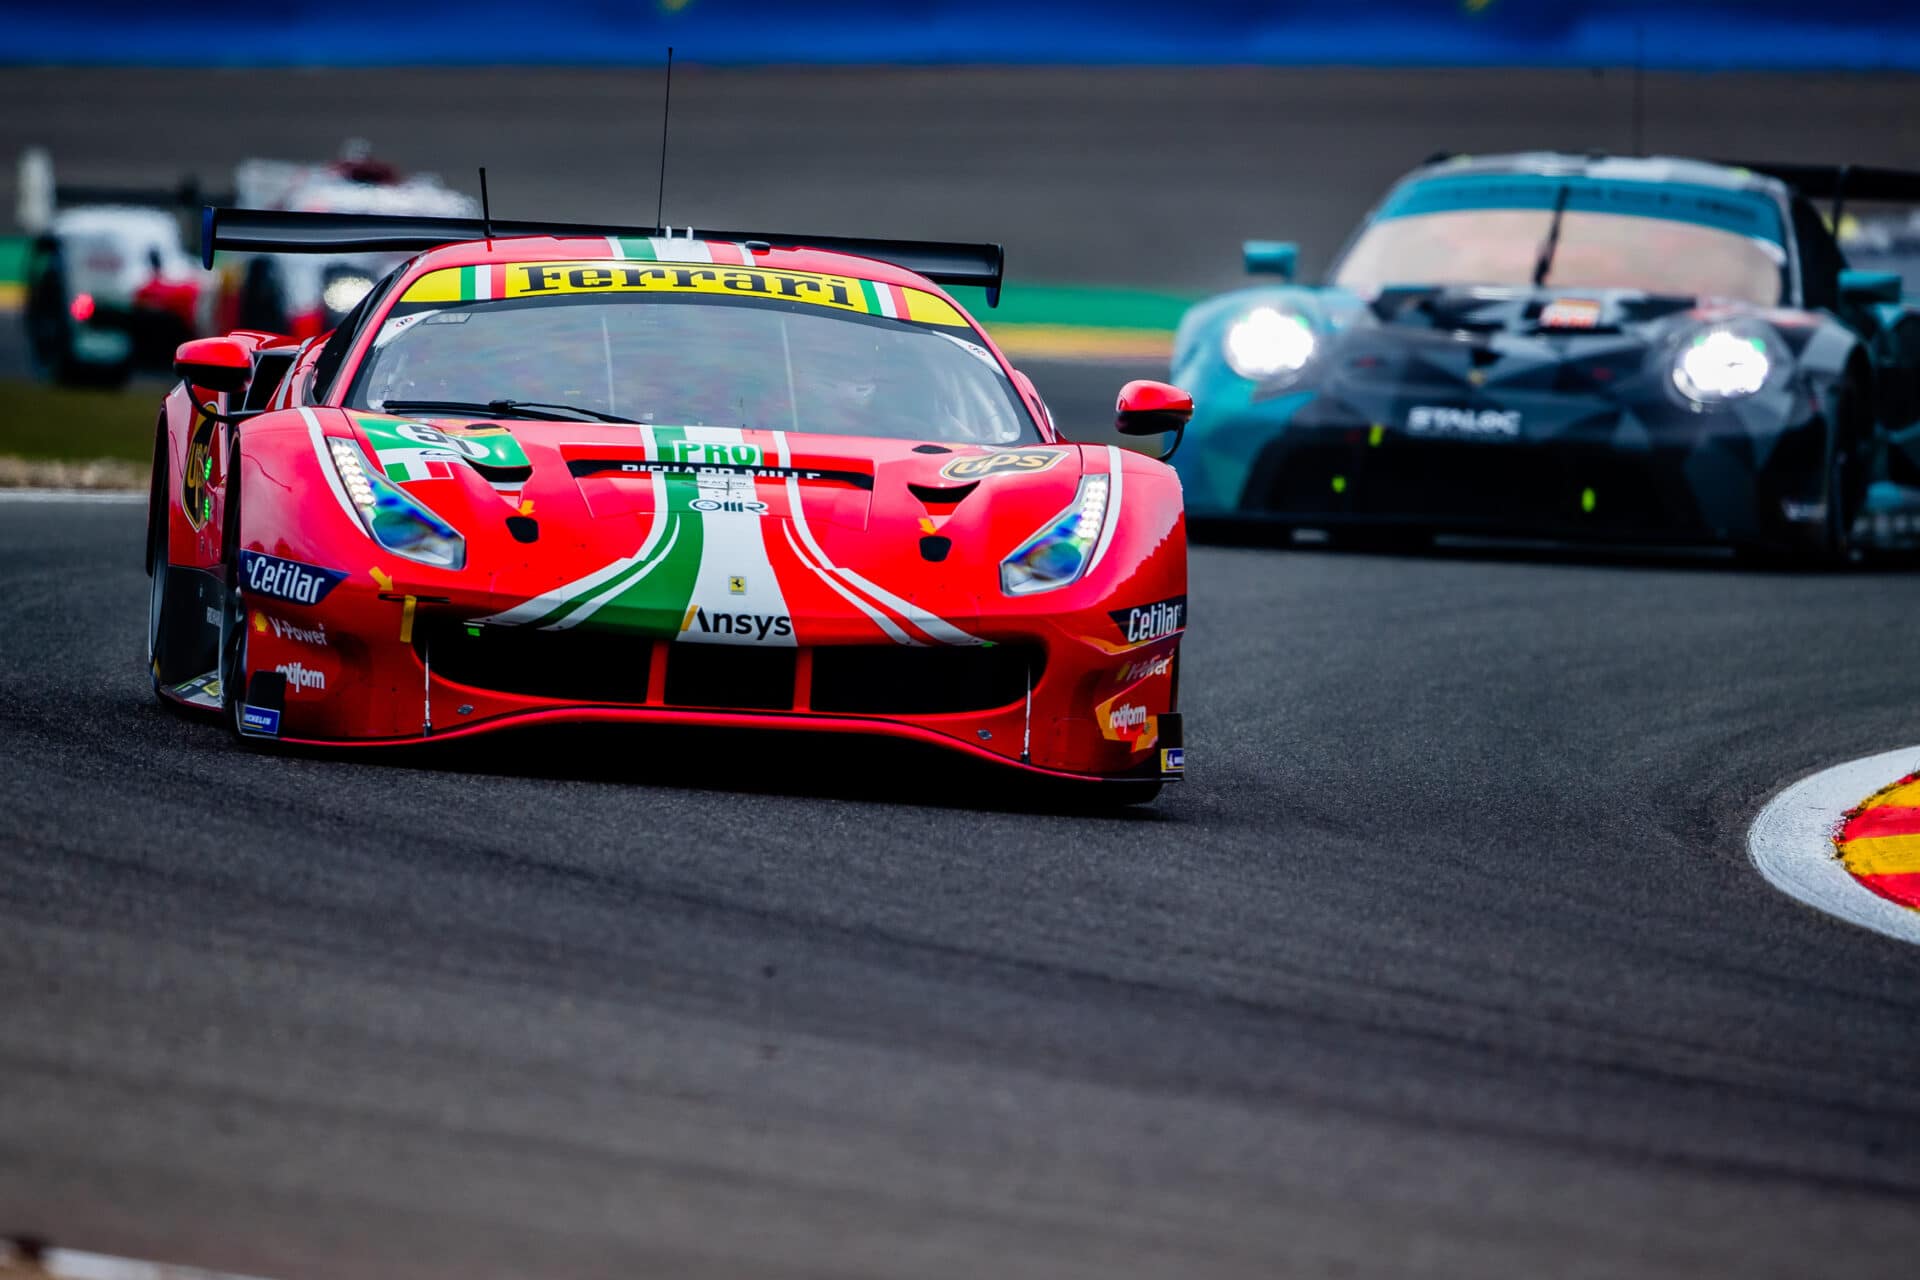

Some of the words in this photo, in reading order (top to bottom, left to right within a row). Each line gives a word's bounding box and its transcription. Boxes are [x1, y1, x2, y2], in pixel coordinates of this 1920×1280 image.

[519, 261, 854, 307] Ferrari
[409, 425, 475, 456] 51
[678, 443, 757, 467] PRO
[250, 556, 325, 604] Cetilar
[268, 615, 327, 646] V-Power
[680, 604, 791, 641] Ansys
[1128, 602, 1180, 642] Cetilar
